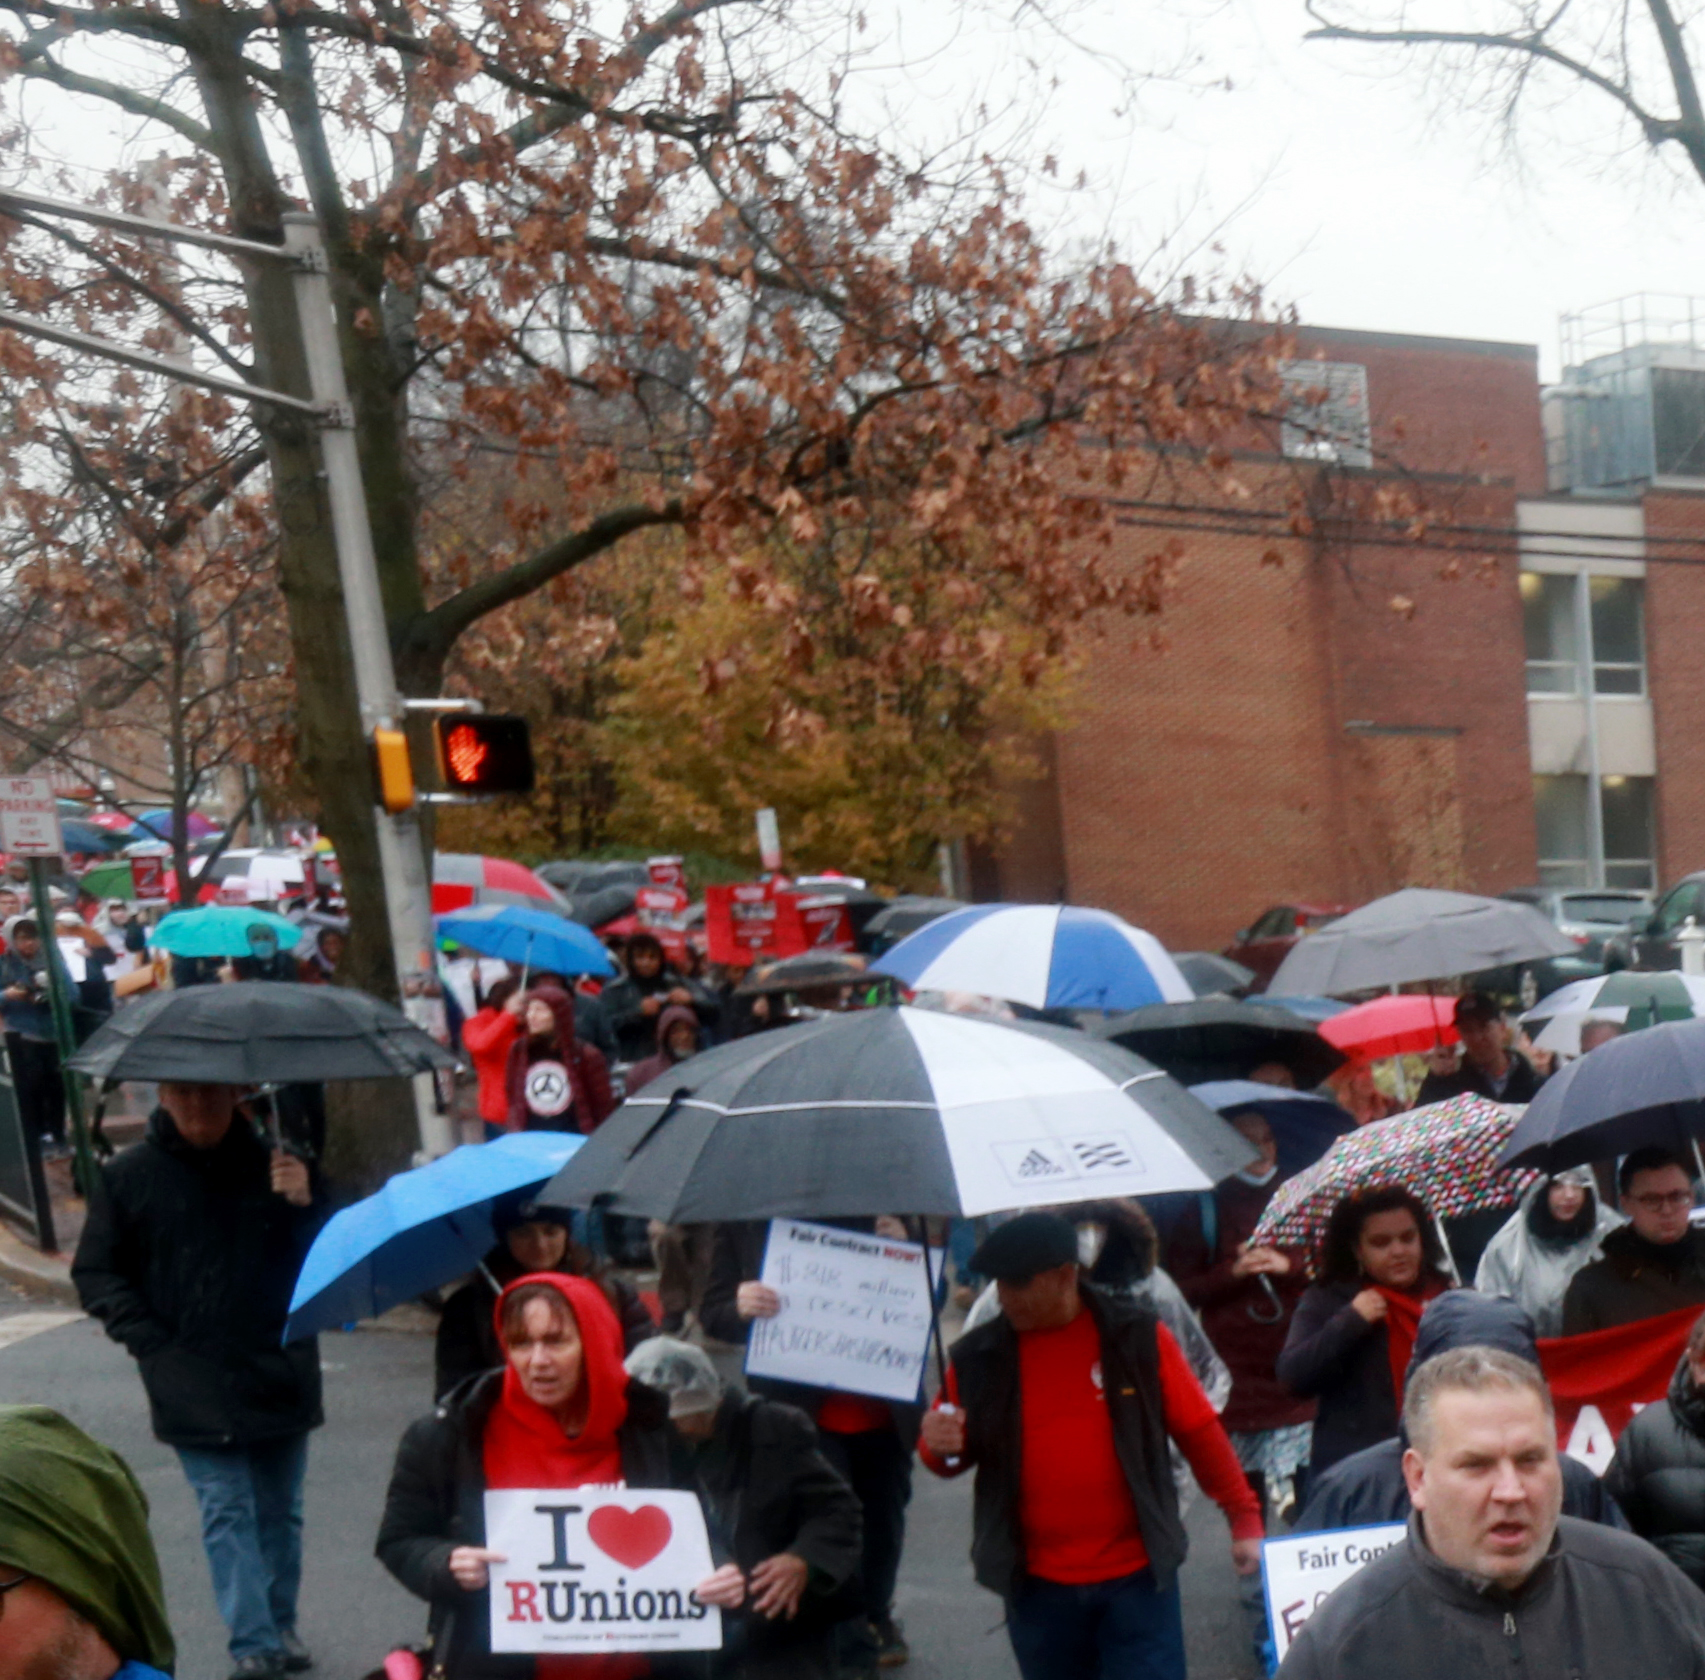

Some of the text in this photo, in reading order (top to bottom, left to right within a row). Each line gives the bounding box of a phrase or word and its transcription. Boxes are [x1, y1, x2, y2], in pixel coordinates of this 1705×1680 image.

[788, 1224, 816, 1244] Fair
[819, 1231, 880, 1256] Contract
[534, 1504, 586, 1572] I
[1297, 1540, 1392, 1571] Fair Con
[505, 1576, 709, 1623] RUnions
